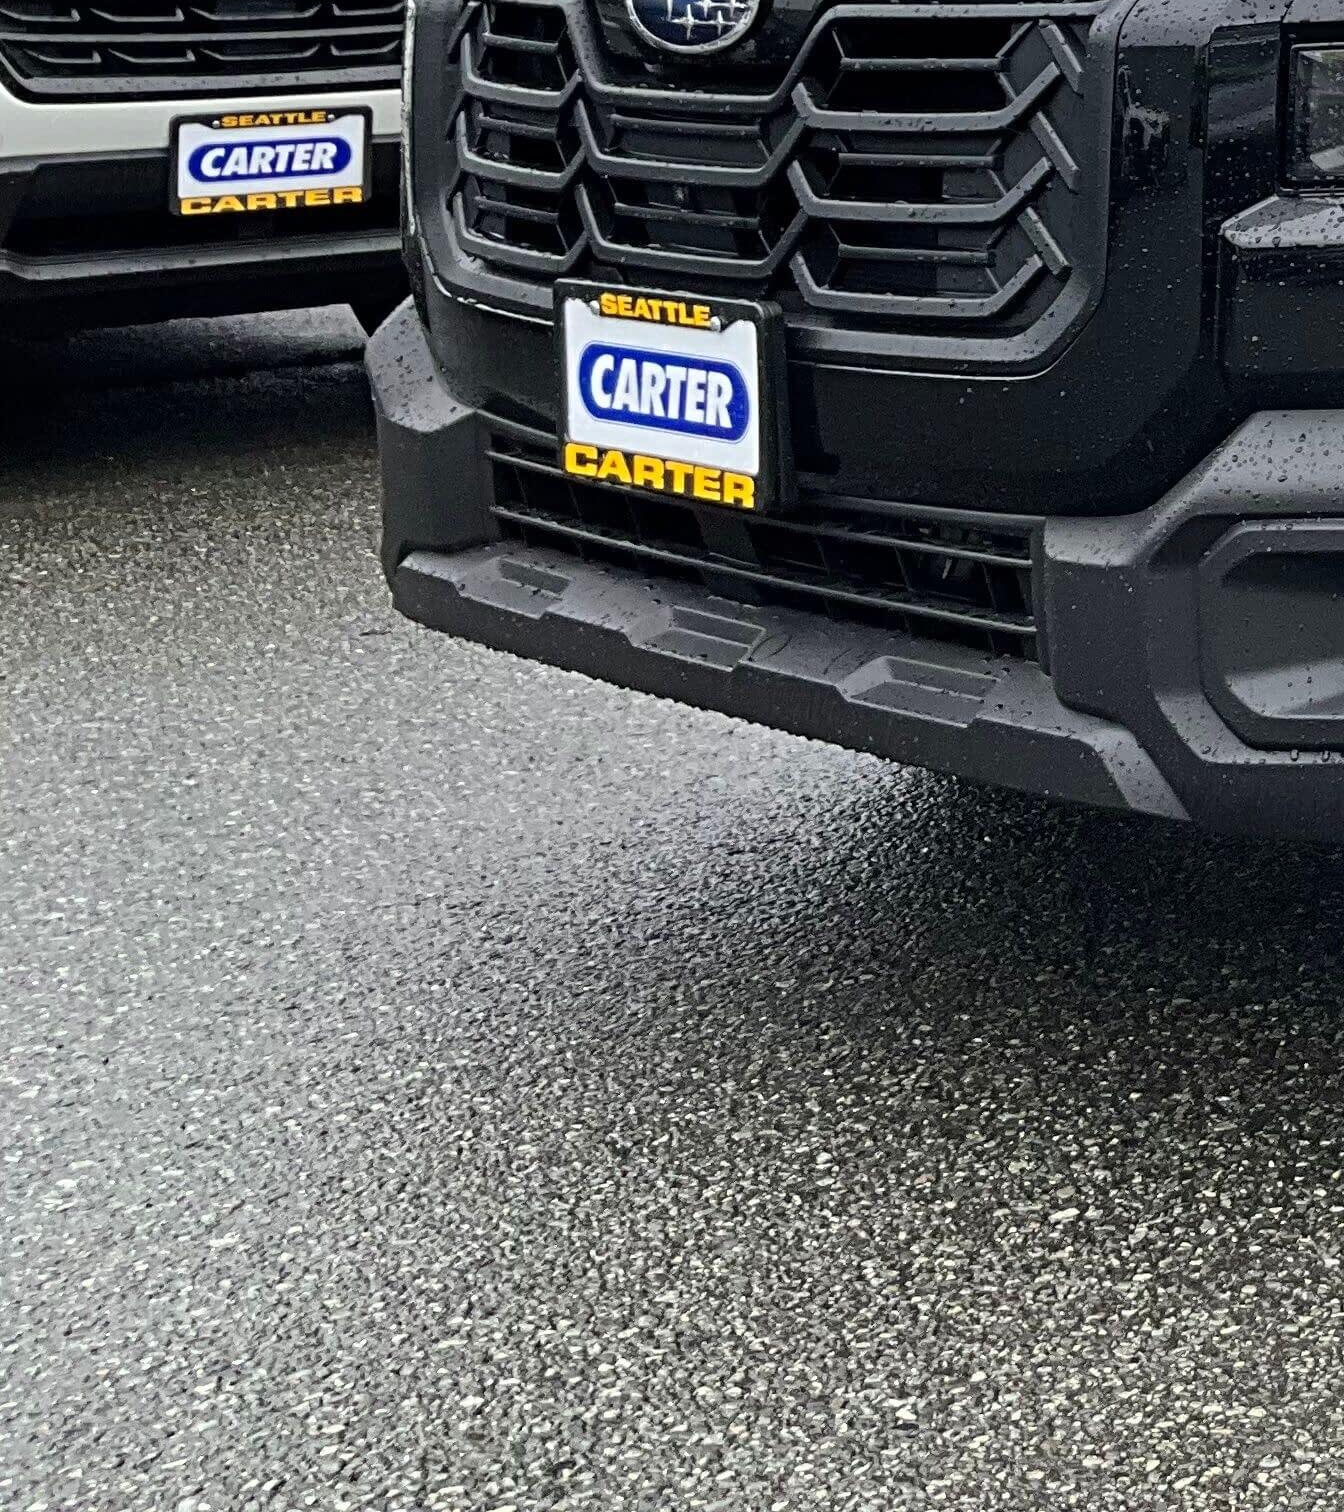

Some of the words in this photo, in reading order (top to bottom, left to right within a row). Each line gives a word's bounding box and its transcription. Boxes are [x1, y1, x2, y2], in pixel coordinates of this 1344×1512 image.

[221, 111, 327, 129] SEATTLE
[201, 142, 337, 177] CARTER
[180, 186, 364, 216] CARTER
[600, 292, 712, 327] SEATTLE
[591, 353, 734, 429] CARTER
[564, 442, 755, 509] CARTER
